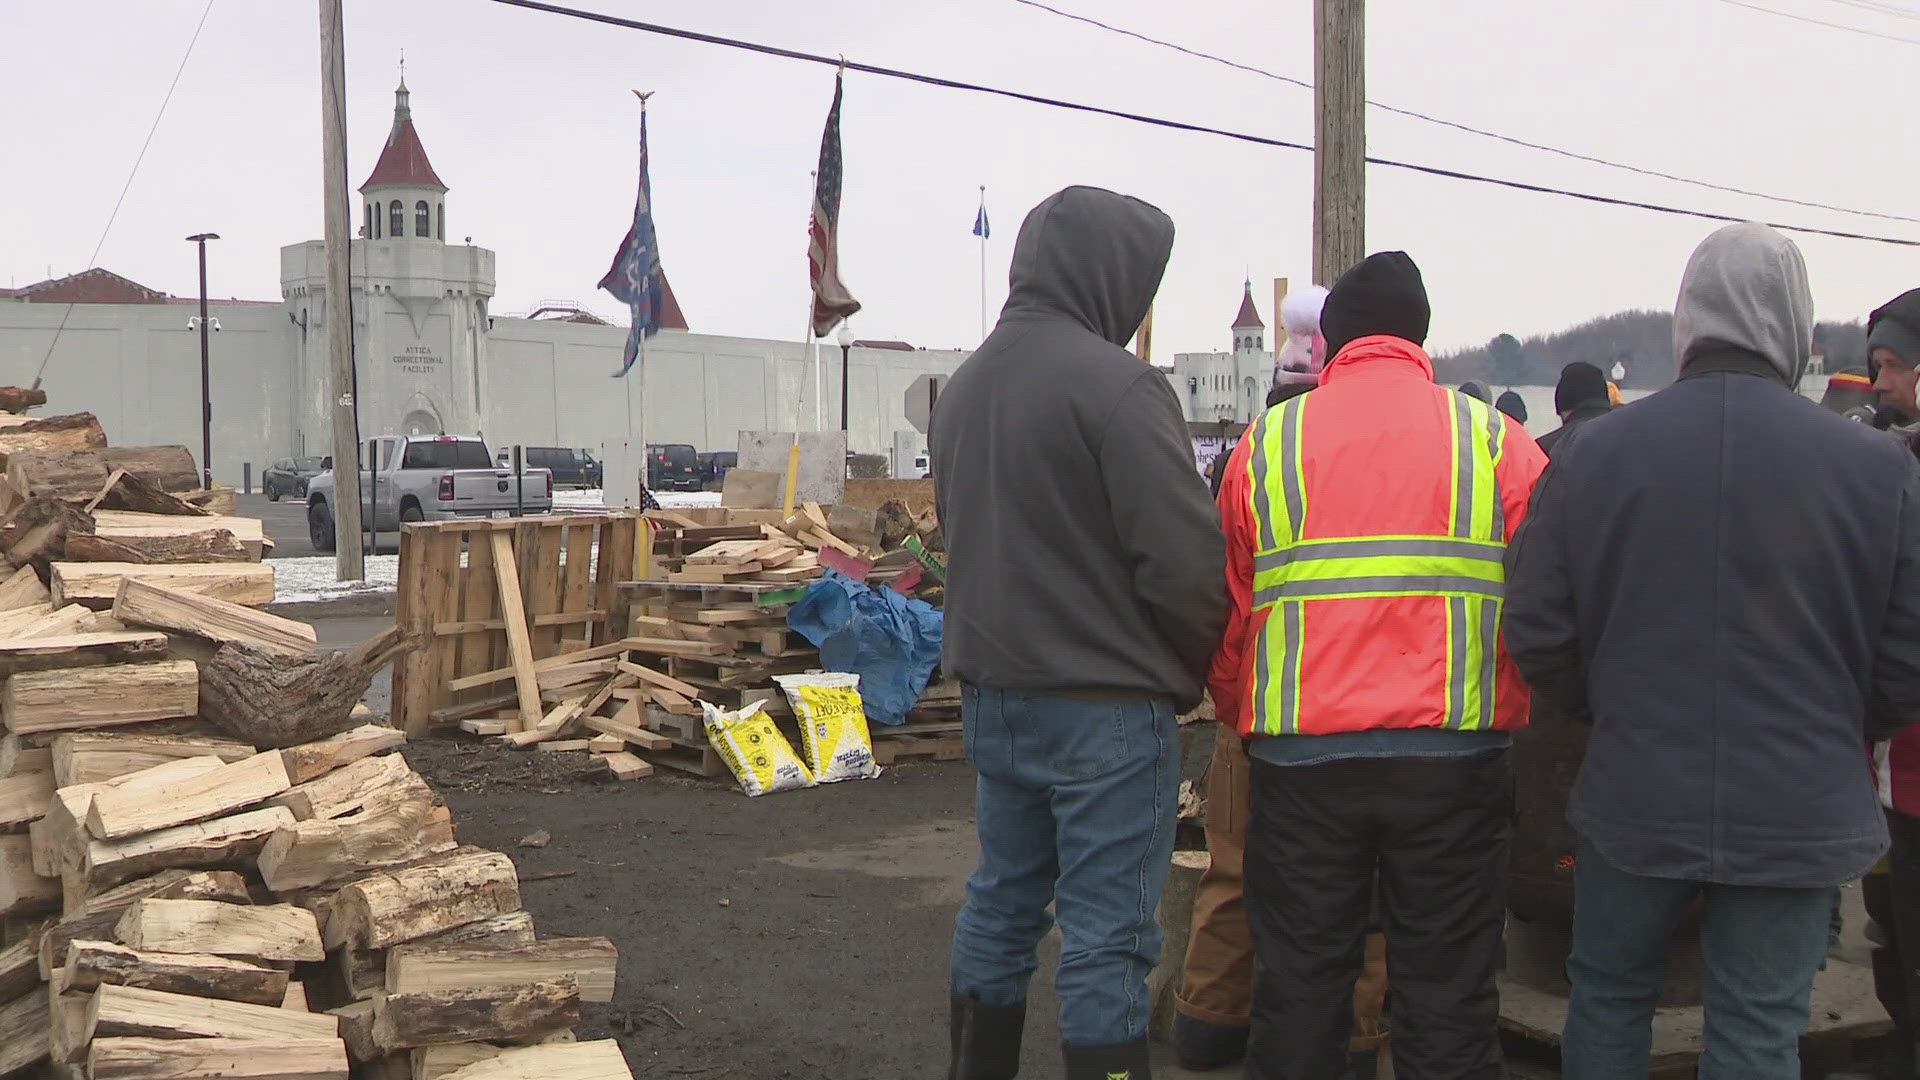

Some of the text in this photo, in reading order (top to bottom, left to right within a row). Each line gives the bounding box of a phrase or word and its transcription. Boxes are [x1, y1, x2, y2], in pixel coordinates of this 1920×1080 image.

[405, 346, 431, 354] ATTICA
[393, 356, 443, 364] CORRECTIONAL
[403, 365, 434, 373] FACILITY
